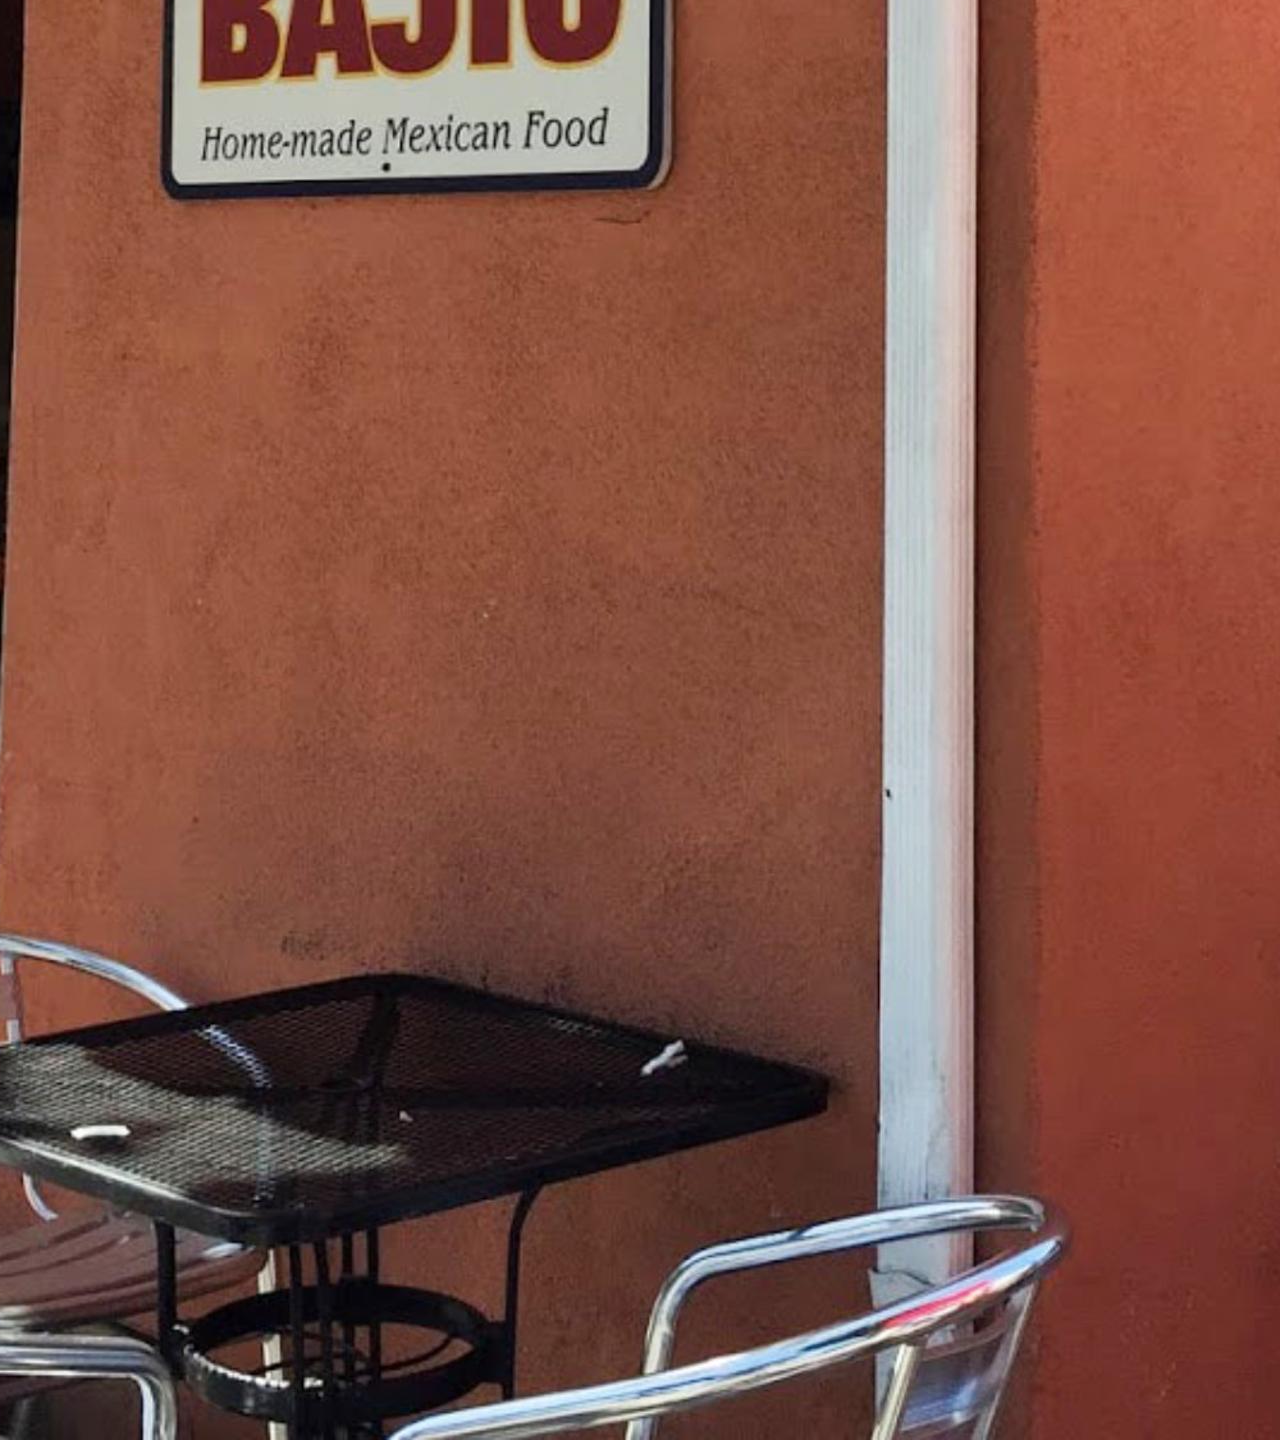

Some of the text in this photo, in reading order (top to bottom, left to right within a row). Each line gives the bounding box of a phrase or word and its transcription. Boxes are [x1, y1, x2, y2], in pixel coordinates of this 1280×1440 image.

[200, 107, 609, 161] Home-made Mexican Food
